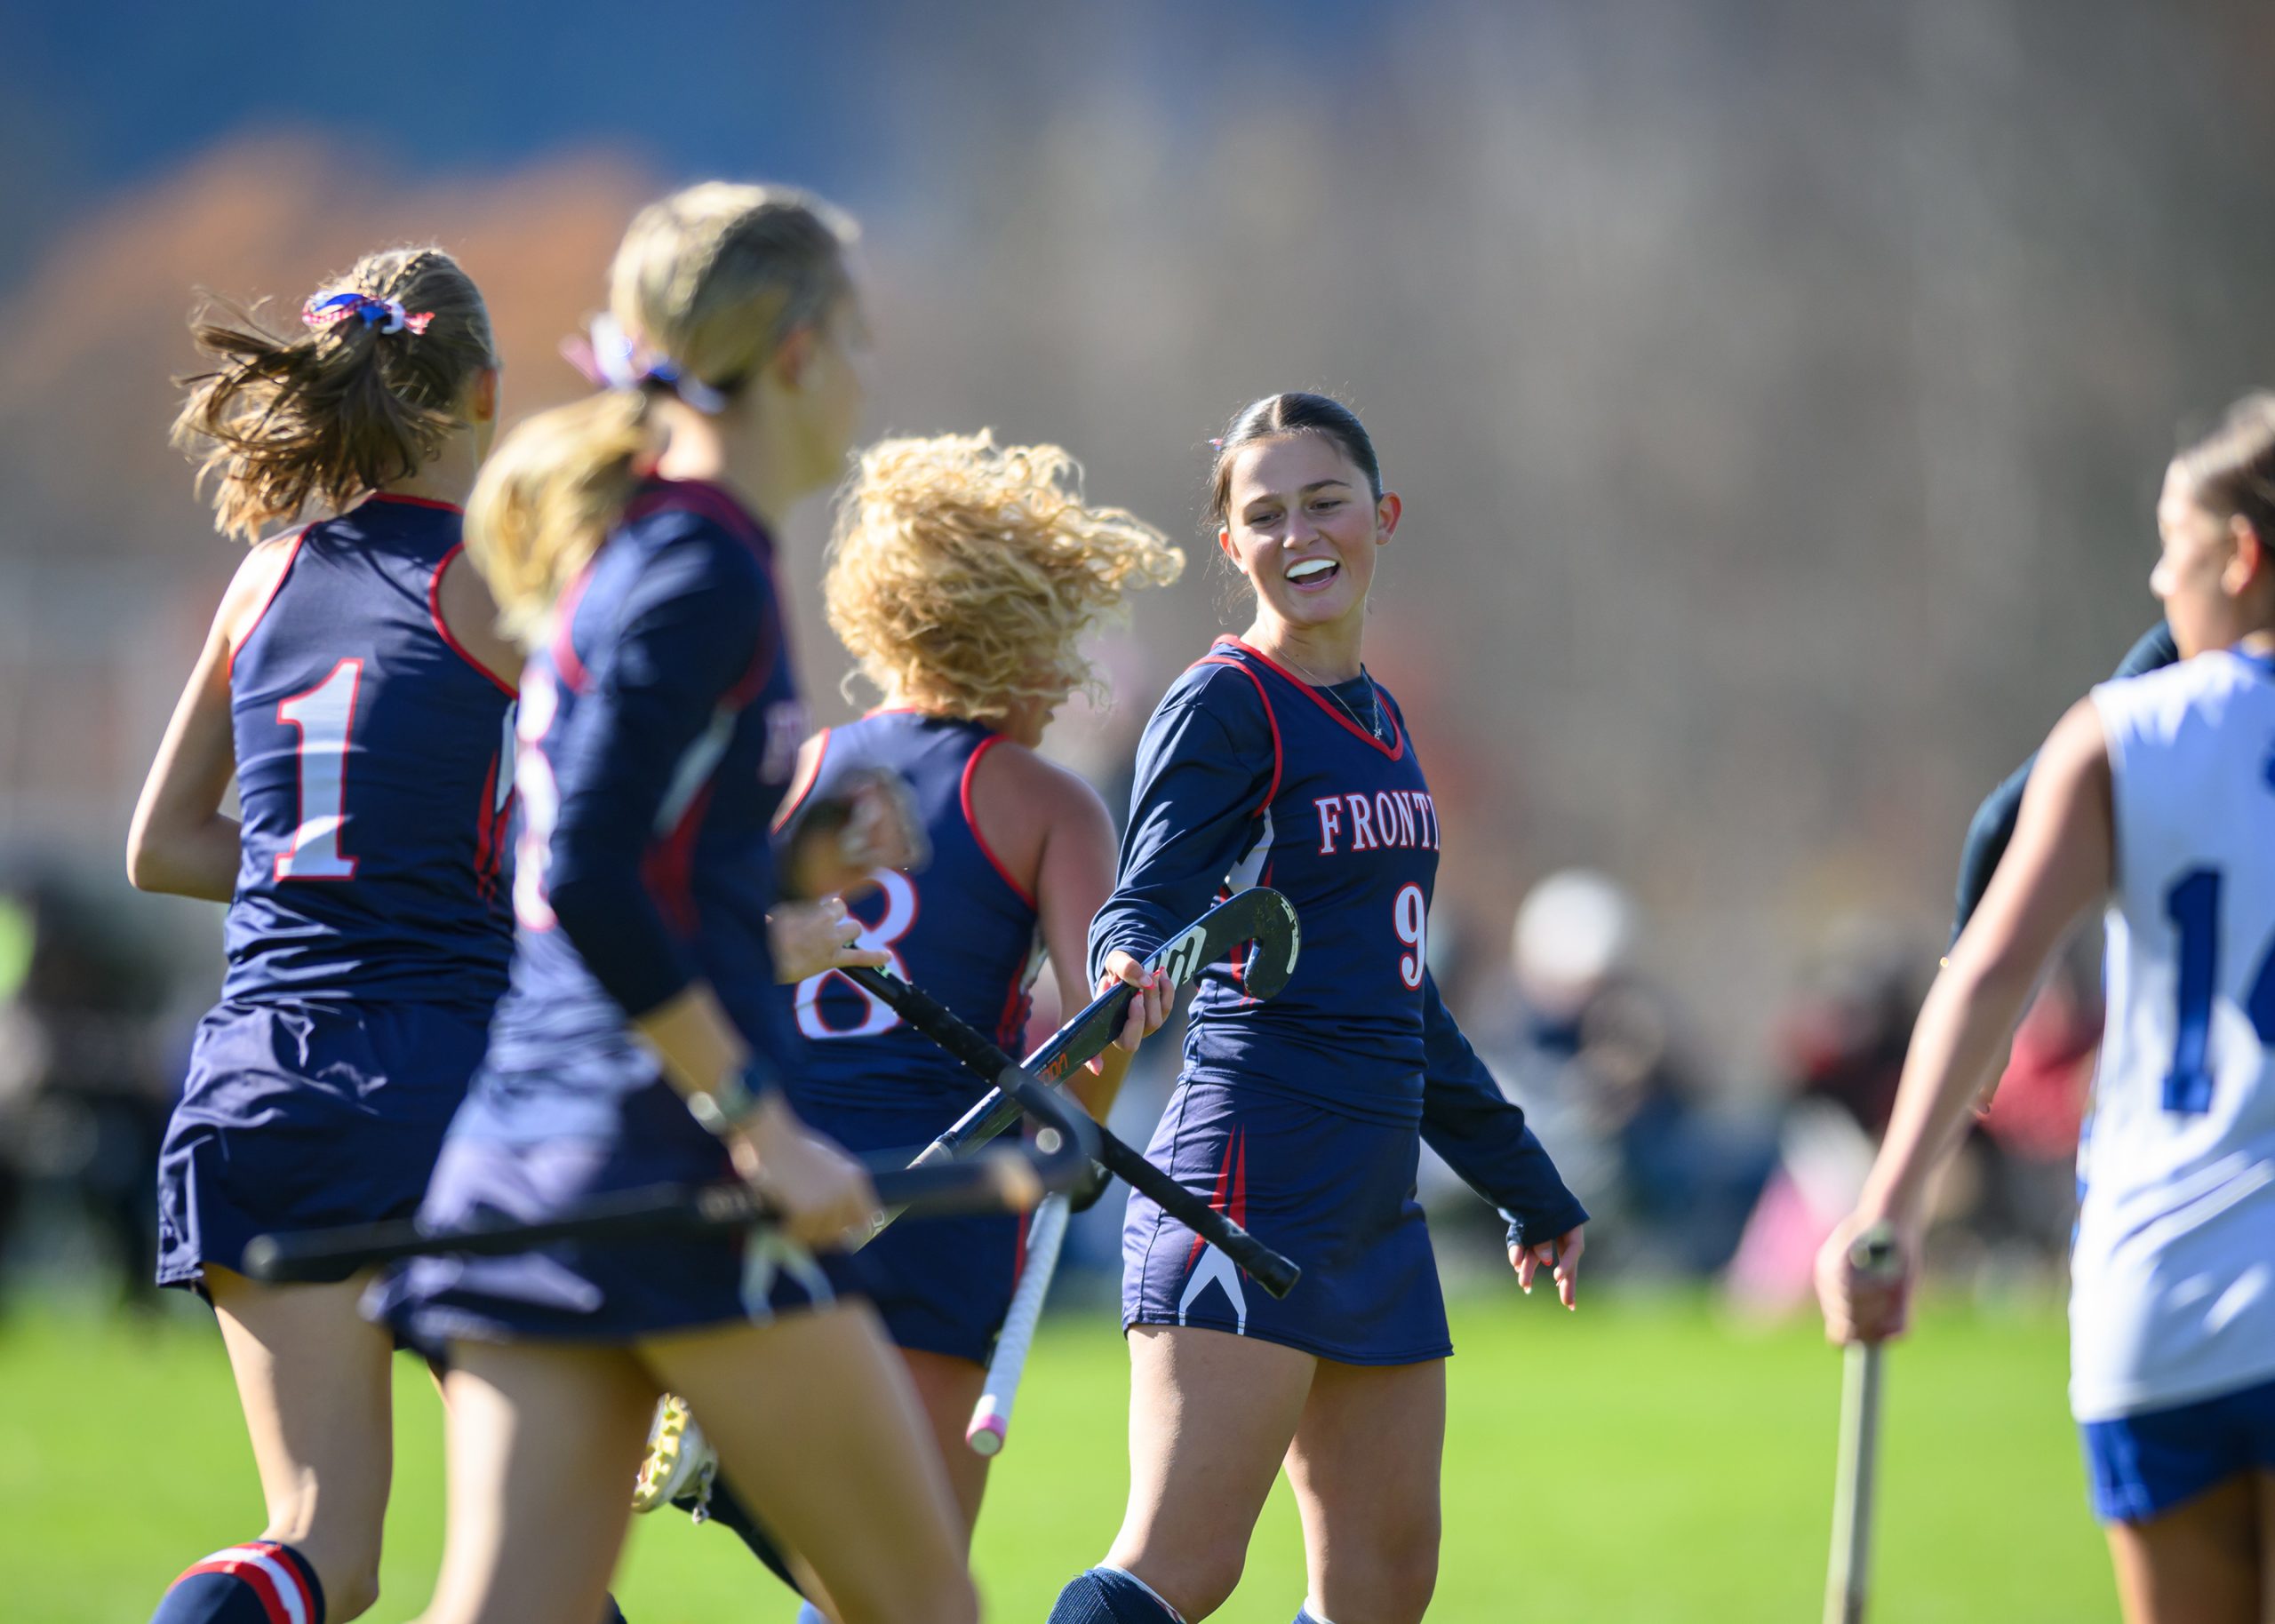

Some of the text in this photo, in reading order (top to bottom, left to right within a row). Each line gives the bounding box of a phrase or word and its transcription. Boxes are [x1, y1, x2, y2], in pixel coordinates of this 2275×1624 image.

[275, 657, 363, 882] 1
[1393, 881, 1425, 991] 9
[2163, 864, 2275, 1113] 1
